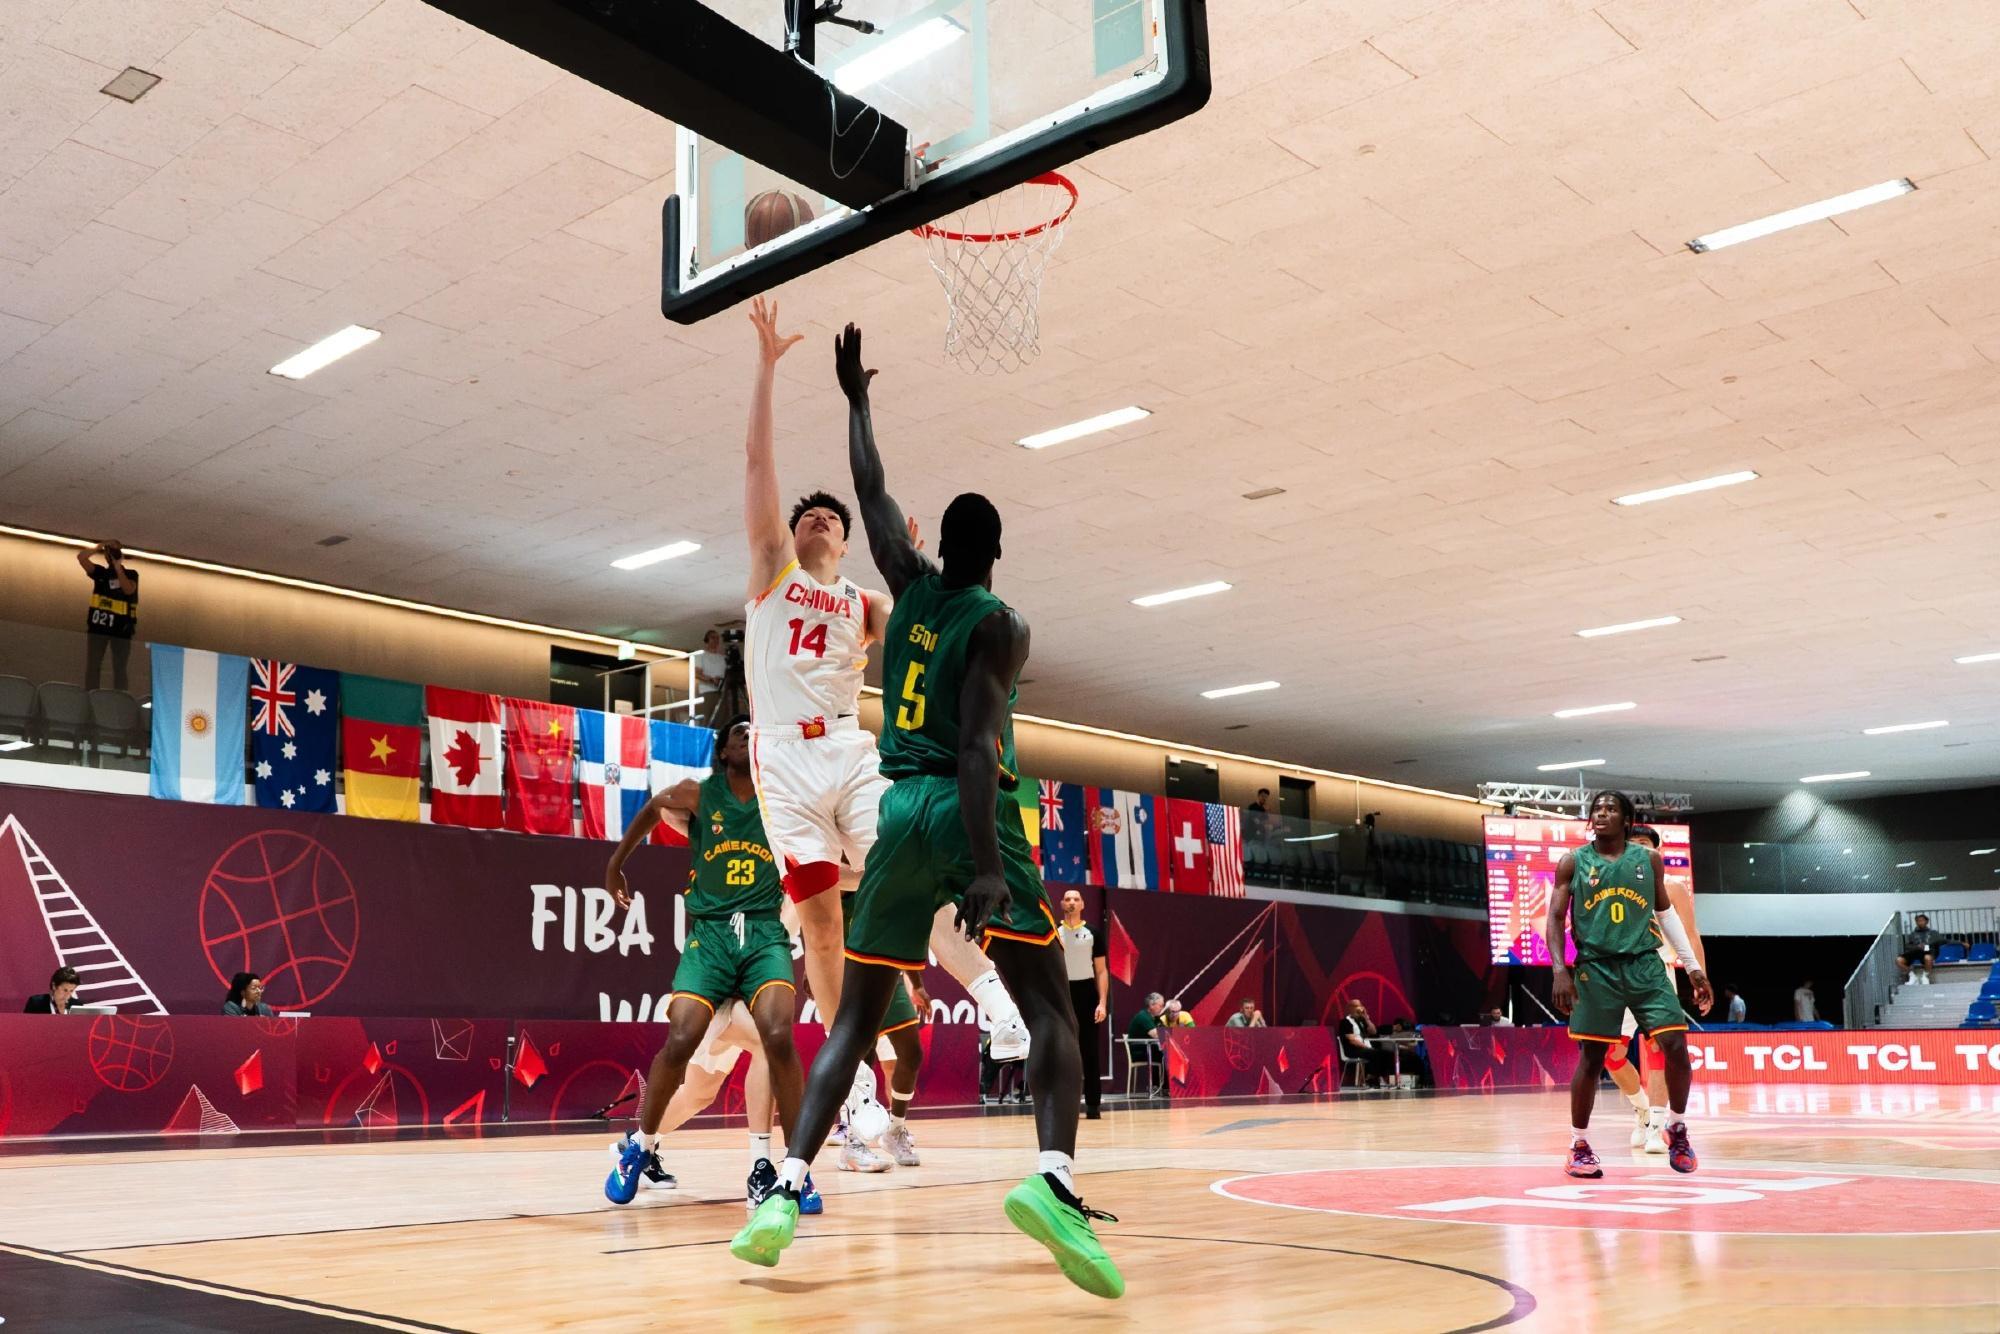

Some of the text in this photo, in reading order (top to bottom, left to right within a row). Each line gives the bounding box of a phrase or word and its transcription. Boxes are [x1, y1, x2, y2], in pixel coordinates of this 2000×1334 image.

[785, 582, 851, 619] CHINA
[92, 609, 115, 628] 021
[788, 617, 828, 658] 14
[896, 660, 926, 731] 5
[726, 859, 755, 885] 23
[530, 884, 655, 958] FIBA
[1611, 902, 1624, 924] 0
[1744, 1045, 1828, 1071] TCL
[1847, 1044, 1936, 1071] TCL
